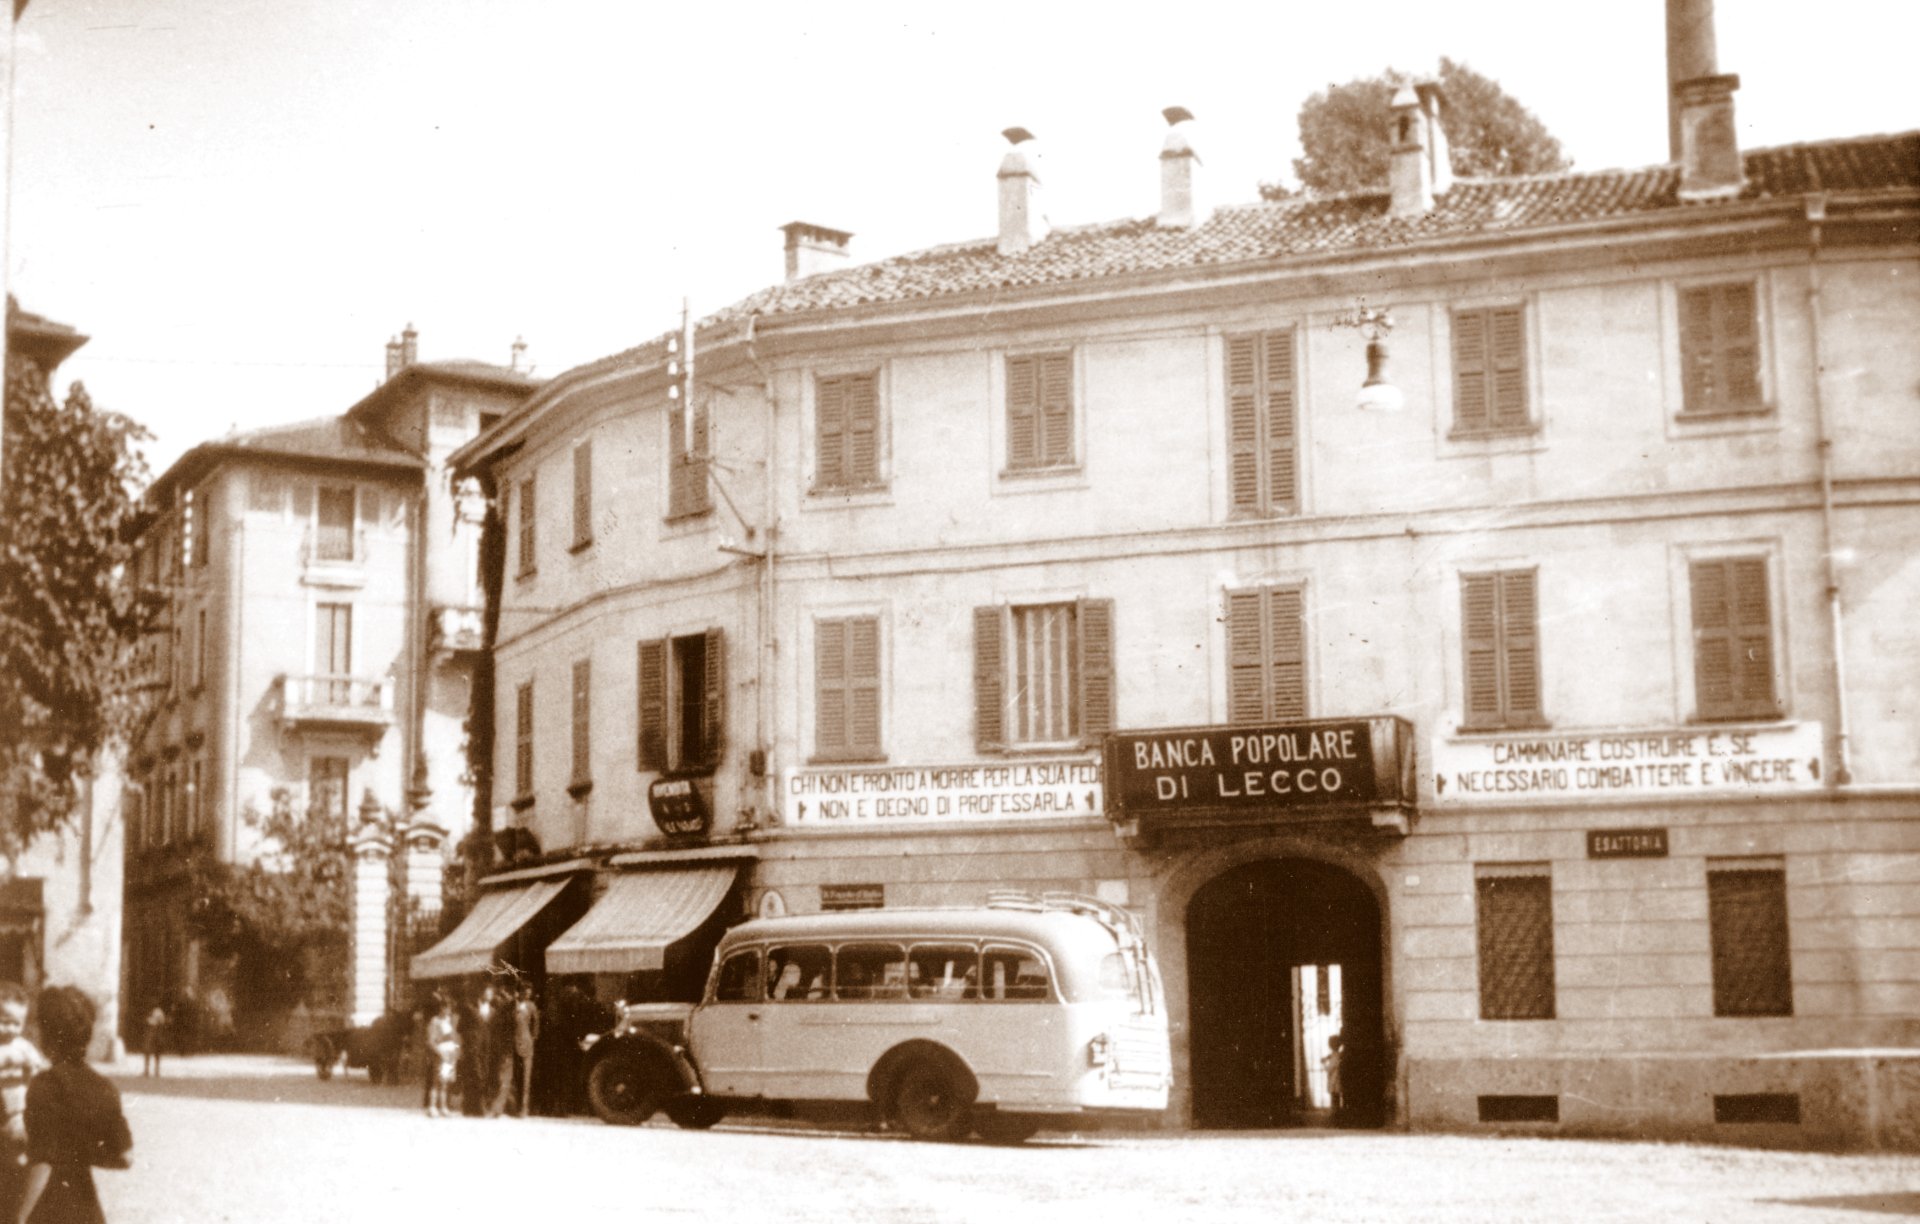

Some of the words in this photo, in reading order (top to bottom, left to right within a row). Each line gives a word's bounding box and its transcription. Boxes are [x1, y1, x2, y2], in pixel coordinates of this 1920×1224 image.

[1134, 739, 1216, 770] BANCA
[1230, 730, 1357, 765] POPOLARE
[1493, 741, 1591, 765] CAMMINARE
[1600, 737, 1697, 760] COSTRUIRE
[1731, 731, 1757, 755] SE
[820, 772, 847, 794] NON
[863, 771, 915, 793] PRONTO
[919, 769, 927, 788] A
[931, 768, 979, 790] MORIRE
[984, 766, 1010, 787] PER
[1014, 764, 1033, 786] LA
[1038, 762, 1066, 786] SUA
[1156, 774, 1188, 800] DI
[1218, 767, 1342, 797] LECCO
[1457, 769, 1568, 792] NECESSARIO
[1577, 763, 1692, 789] COMBATTERE
[1723, 758, 1796, 784] VINCERE
[819, 799, 849, 819] NON
[876, 797, 928, 817] DEGNO
[937, 795, 950, 815] DI
[959, 791, 1075, 814] PROFESSARLA
[1594, 835, 1662, 852] ESATTORIA
